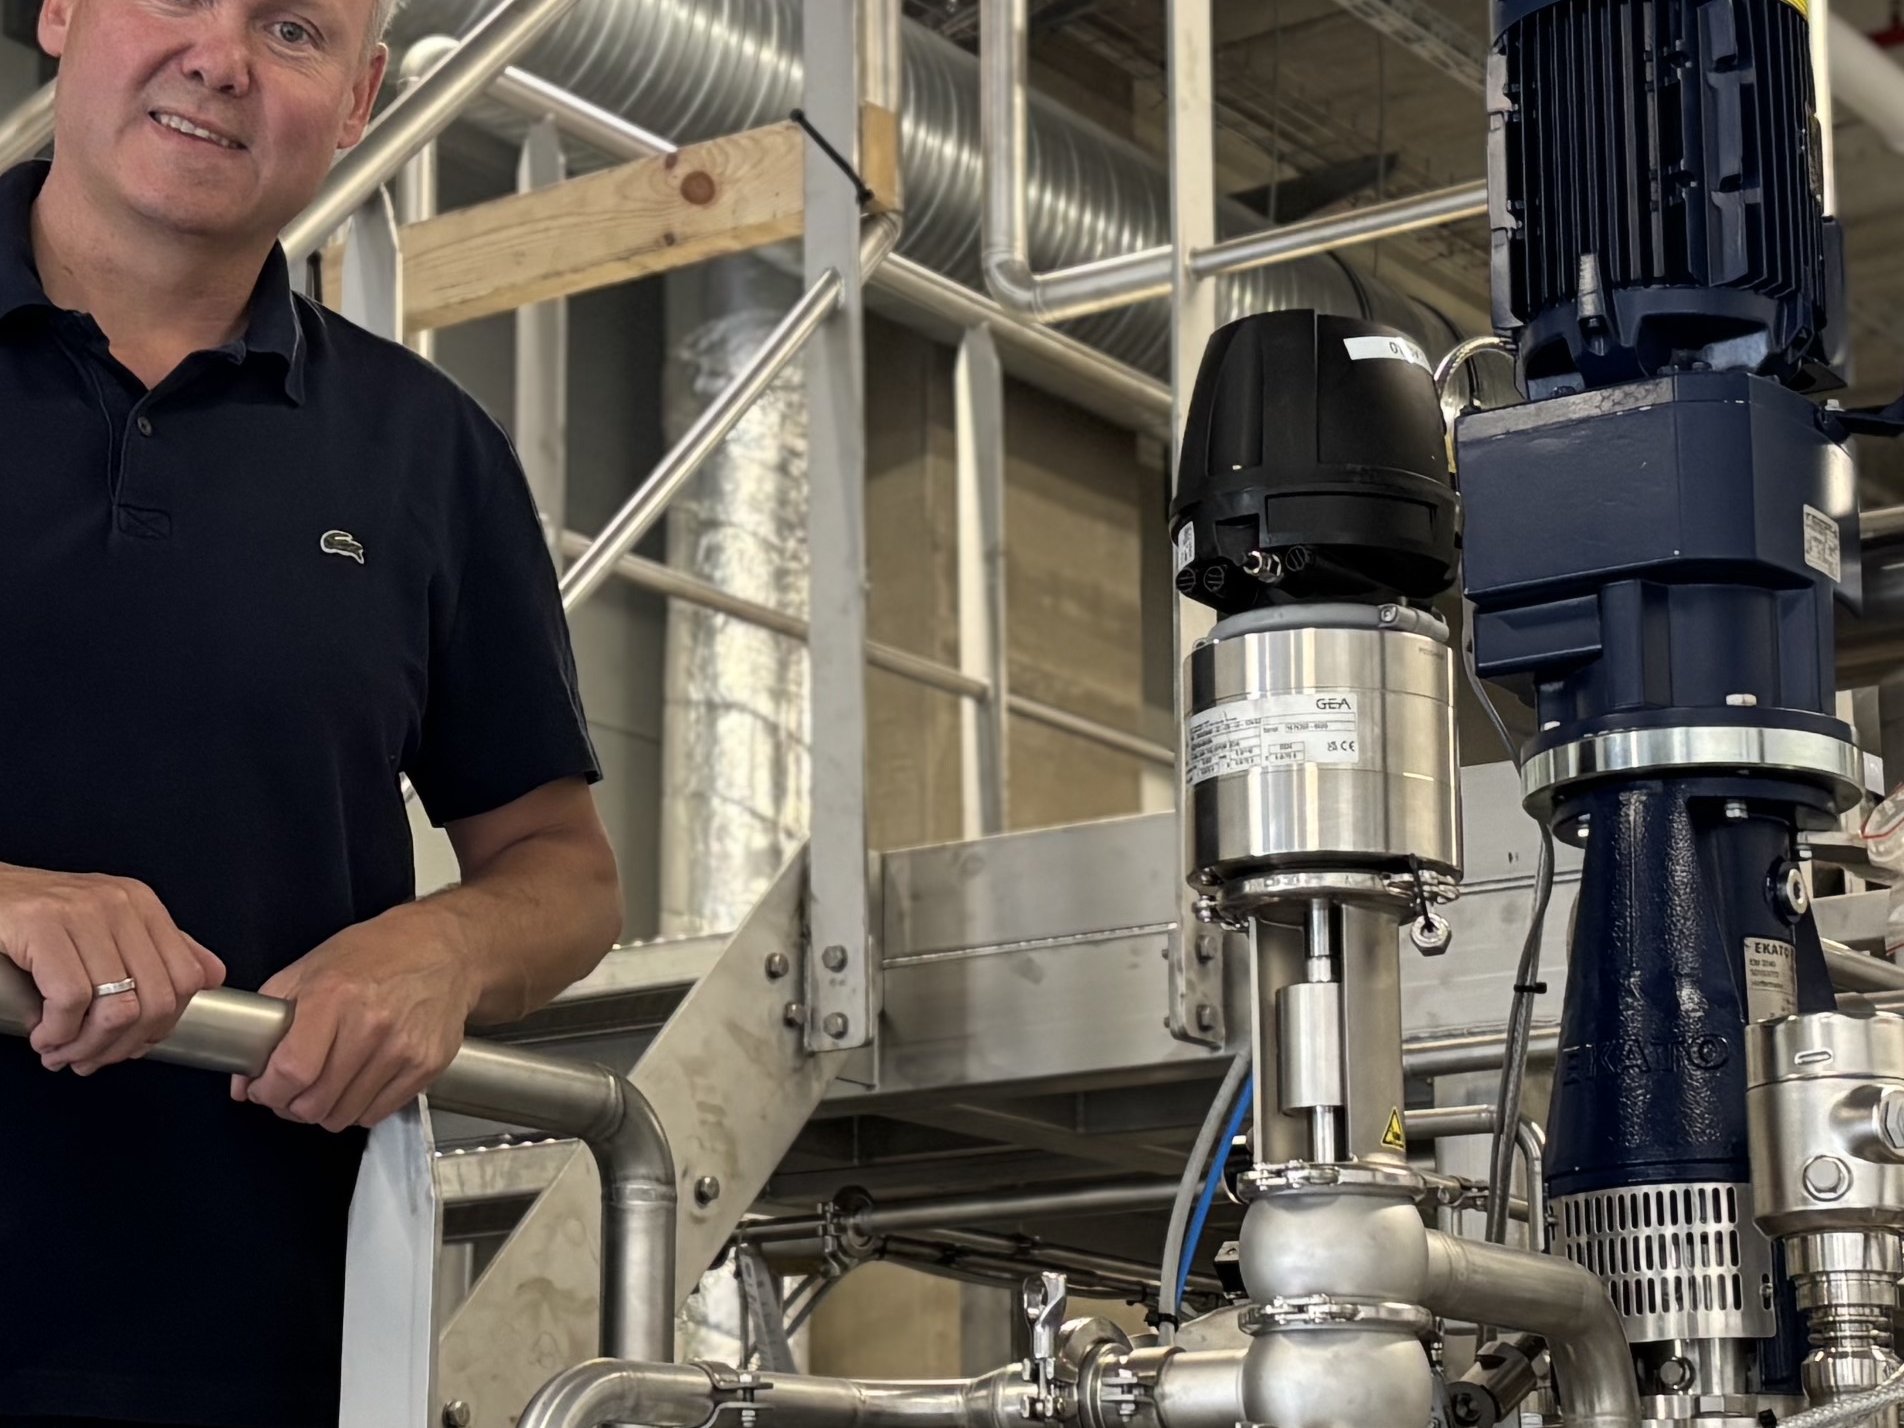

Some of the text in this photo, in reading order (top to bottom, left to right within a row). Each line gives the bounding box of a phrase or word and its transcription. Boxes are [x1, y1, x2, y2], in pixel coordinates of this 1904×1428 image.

[1316, 698, 1351, 710] GEA
[1755, 942, 1791, 958] EKATO
[1563, 1033, 1730, 1086] EKATO
